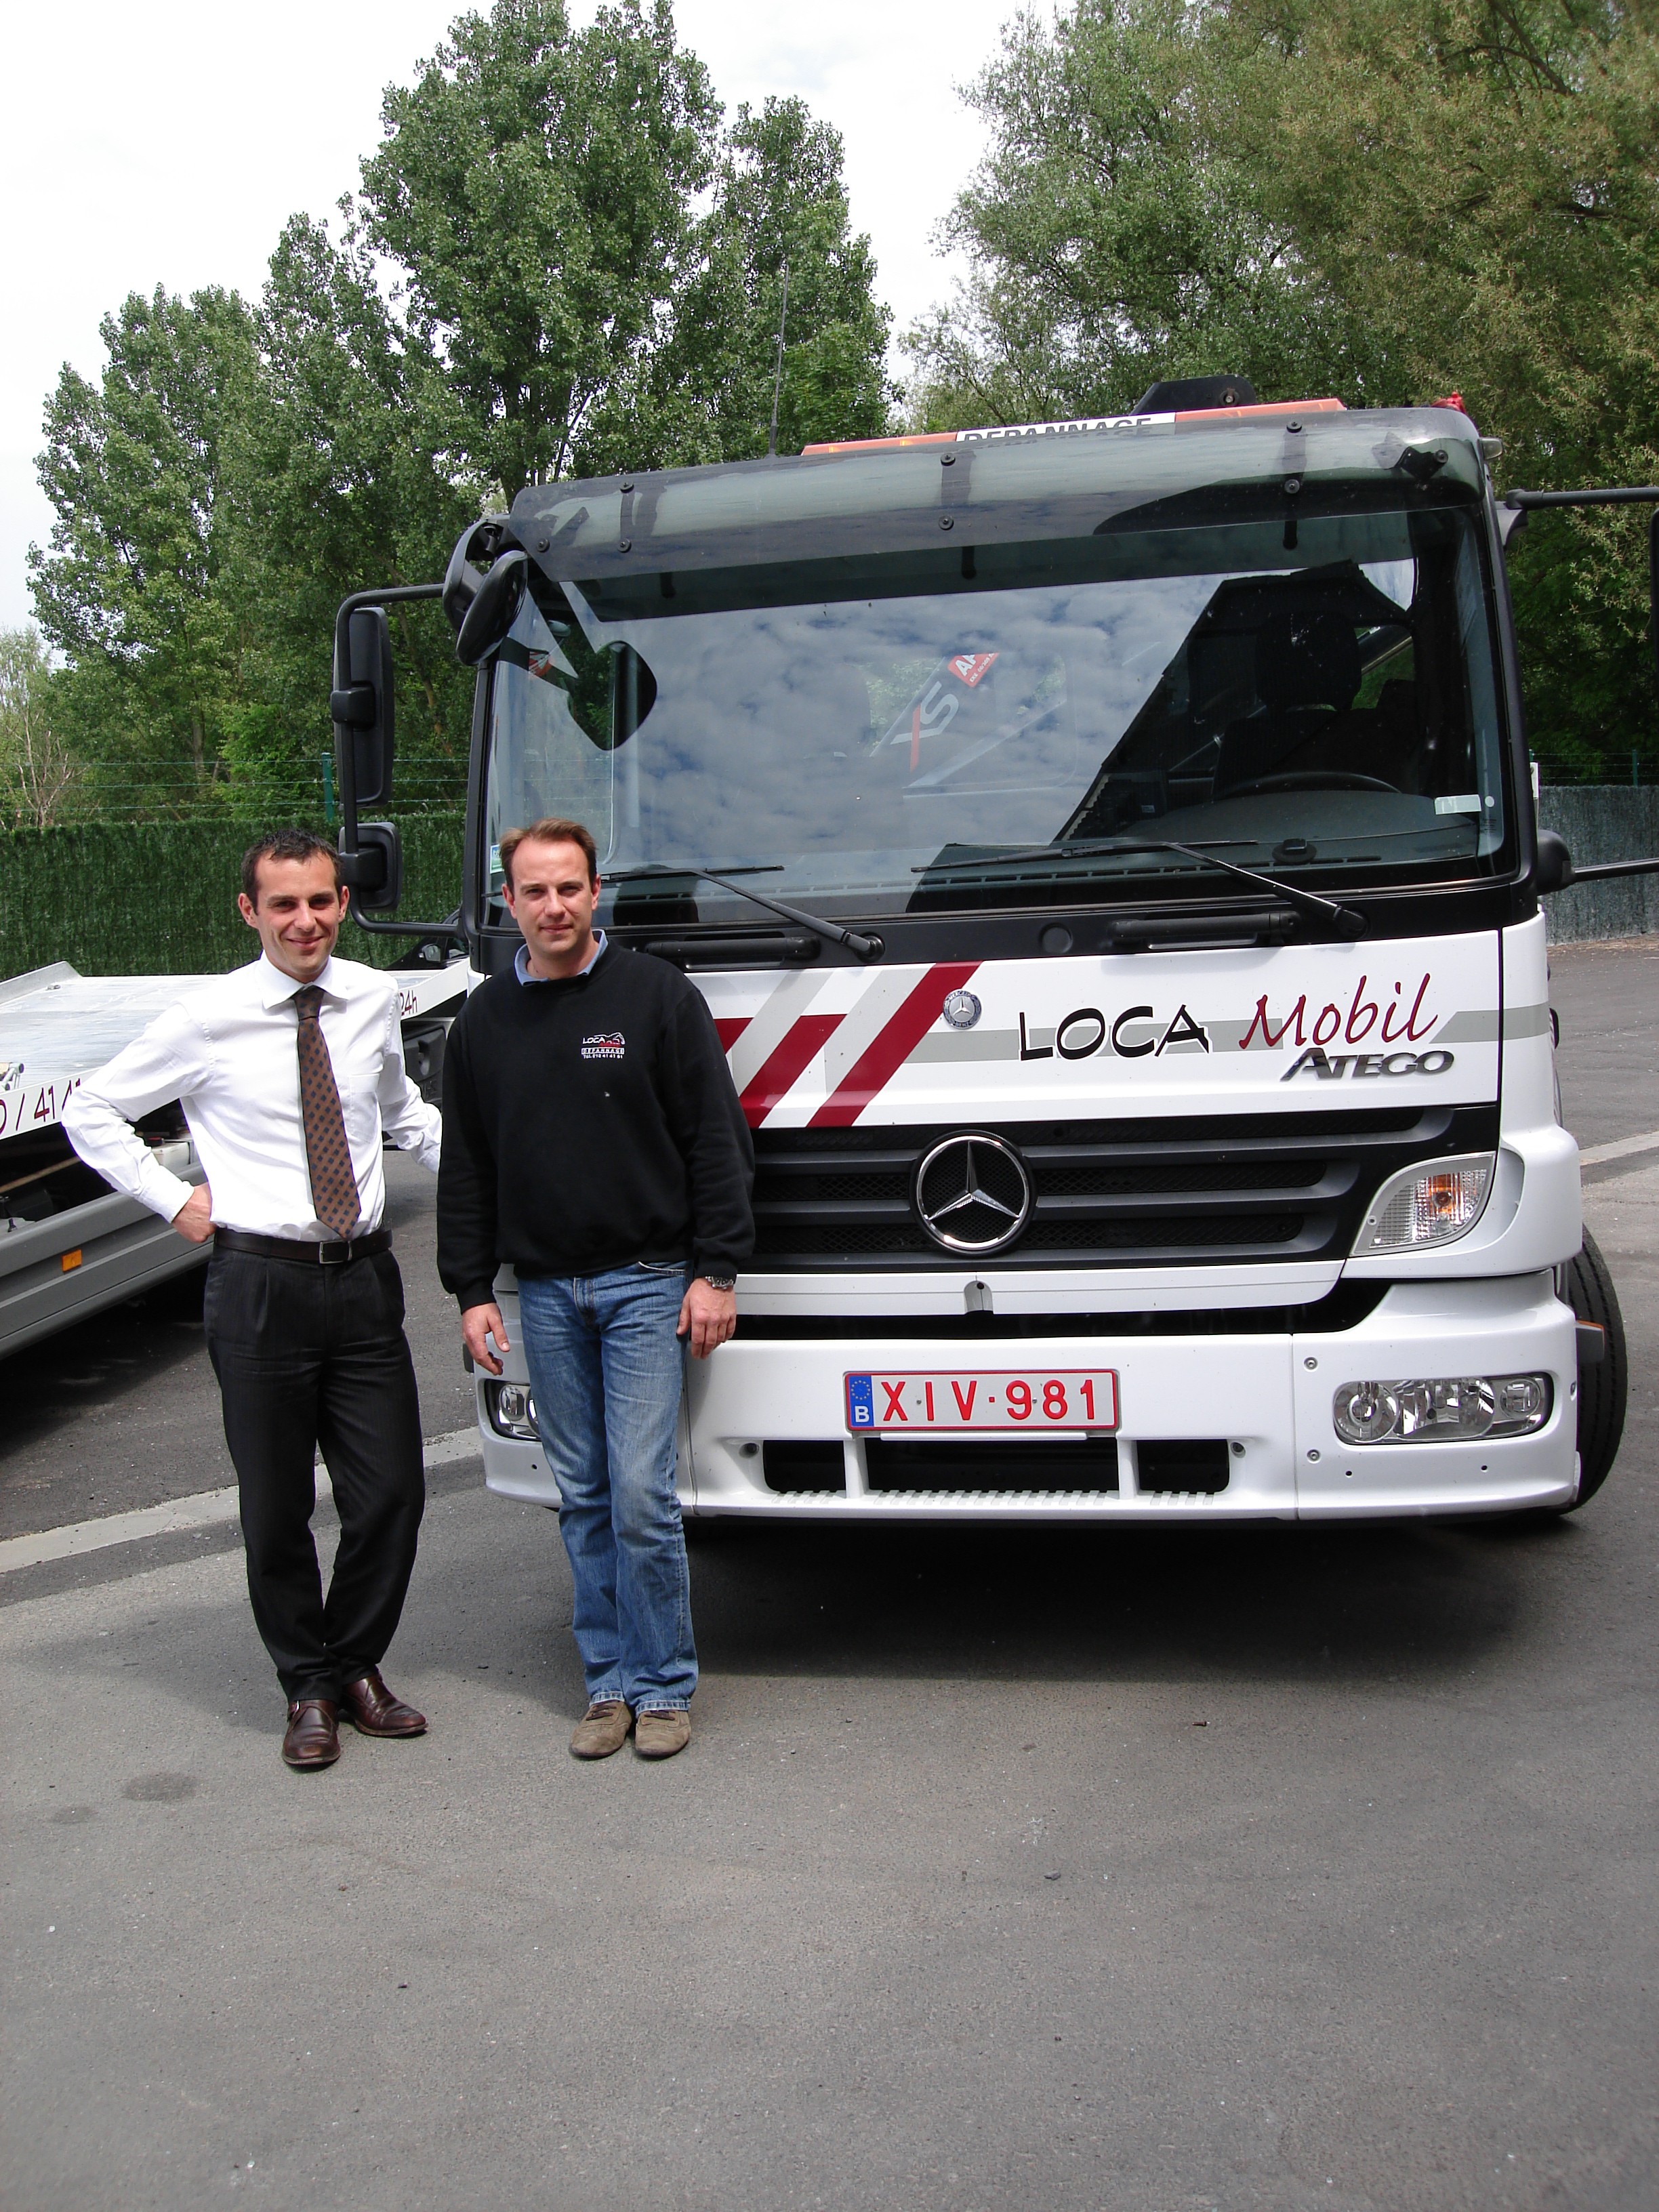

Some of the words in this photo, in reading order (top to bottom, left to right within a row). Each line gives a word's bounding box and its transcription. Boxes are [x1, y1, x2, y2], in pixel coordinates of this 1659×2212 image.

[1019, 1004, 1210, 1062] LOCA
[1238, 972, 1439, 1050] Mobil
[583, 1036, 606, 1044] LOCA
[34, 1086, 56, 1122] 41
[855, 1406, 870, 1423] B
